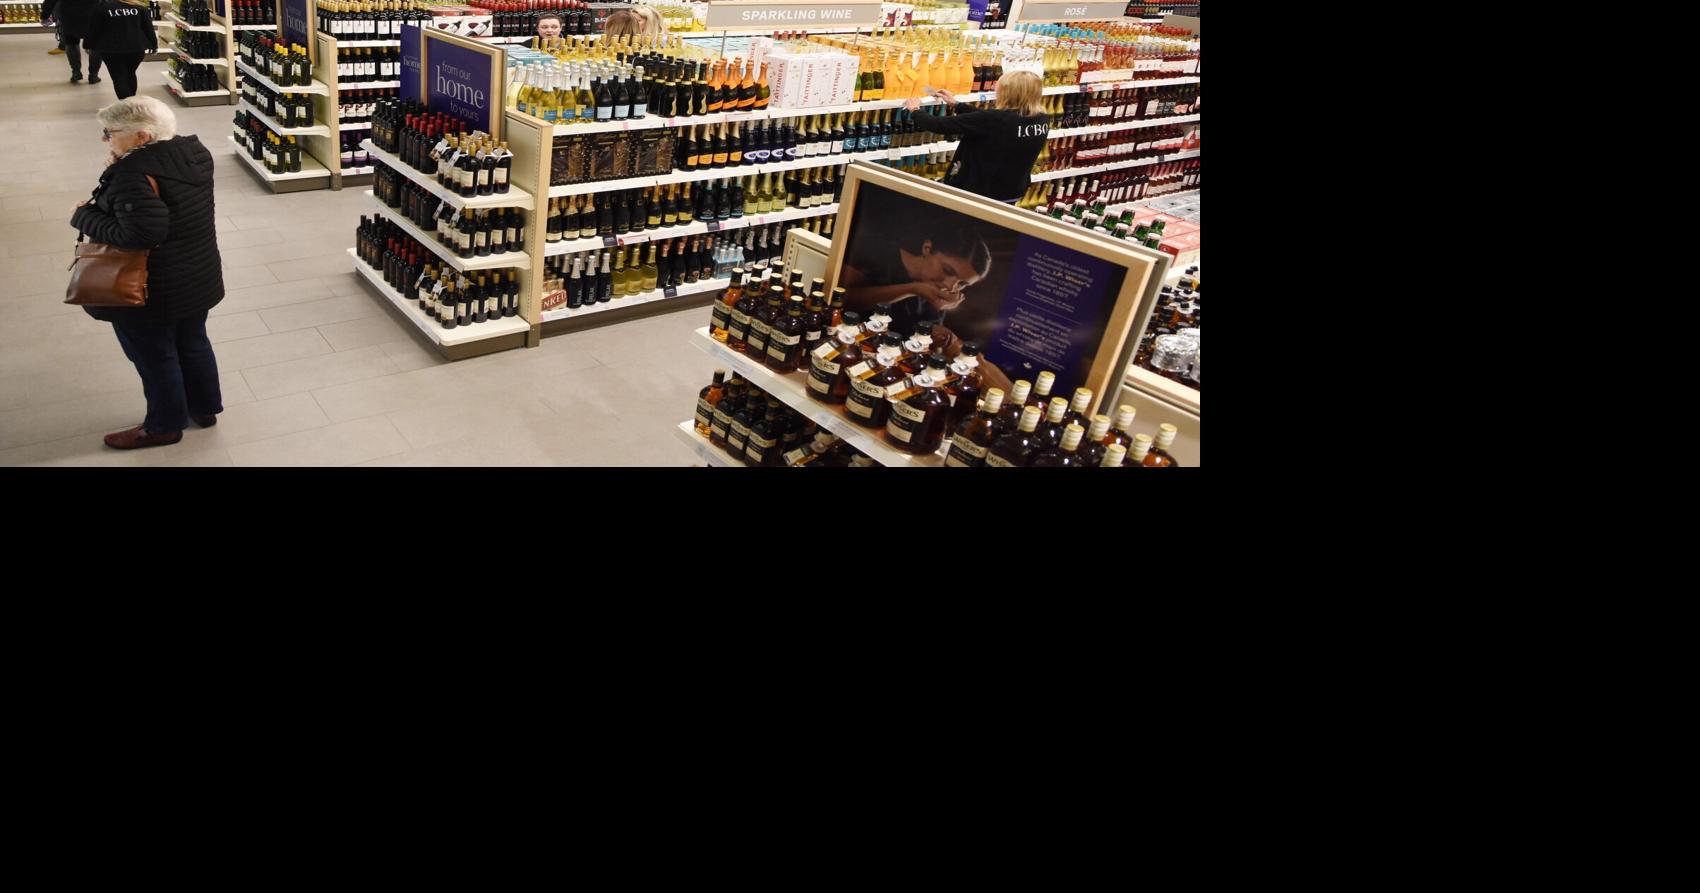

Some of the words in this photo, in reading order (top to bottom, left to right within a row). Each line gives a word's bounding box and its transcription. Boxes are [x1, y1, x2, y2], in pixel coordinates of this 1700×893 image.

[108, 8, 139, 17] LCBO
[742, 9, 817, 21] SPARKLING
[820, 9, 853, 19] WINE
[1064, 6, 1088, 16] ROSÉ
[442, 61, 458, 77] from
[459, 69, 471, 80] our
[436, 65, 484, 108] home
[773, 62, 785, 103] TAITTINGER
[803, 63, 814, 104] TAITTINGER
[831, 62, 842, 102] TAITTINGER
[450, 101, 458, 113] to
[459, 106, 479, 122] yours
[1017, 123, 1049, 138] LCBO
